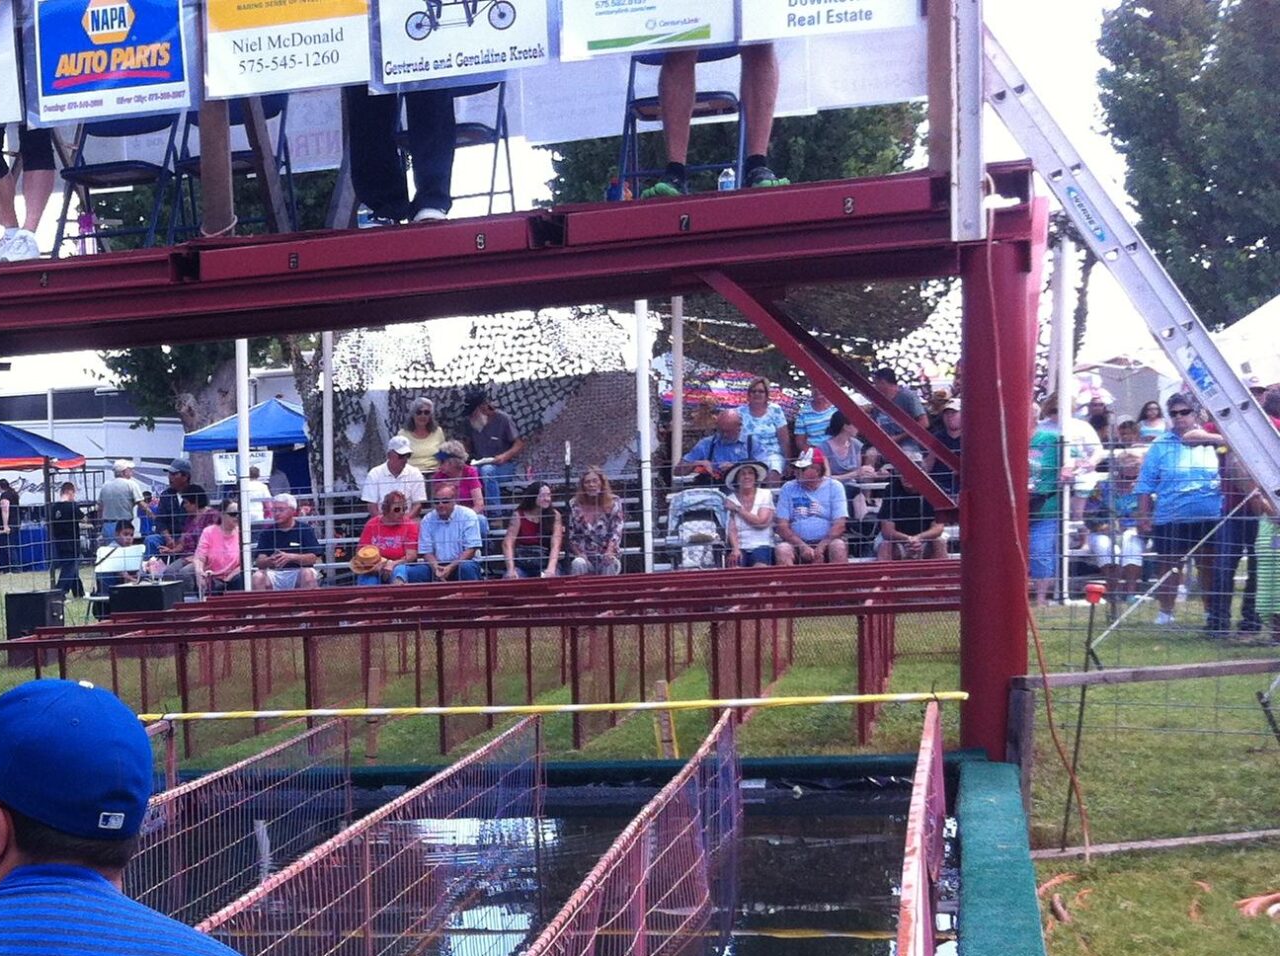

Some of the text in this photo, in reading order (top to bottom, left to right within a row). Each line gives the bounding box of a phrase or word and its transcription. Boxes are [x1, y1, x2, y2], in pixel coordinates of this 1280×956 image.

[90, 6, 127, 31] NAPA
[787, 8, 873, 27] Real Estate
[232, 27, 344, 54] Niel McDonald
[54, 42, 171, 77] AUTO PARTS
[238, 49, 340, 74] 575-545-1260
[385, 57, 430, 76] Gertrude
[433, 53, 452, 70] and
[455, 49, 507, 67] Geraldine
[680, 214, 689, 231] 7
